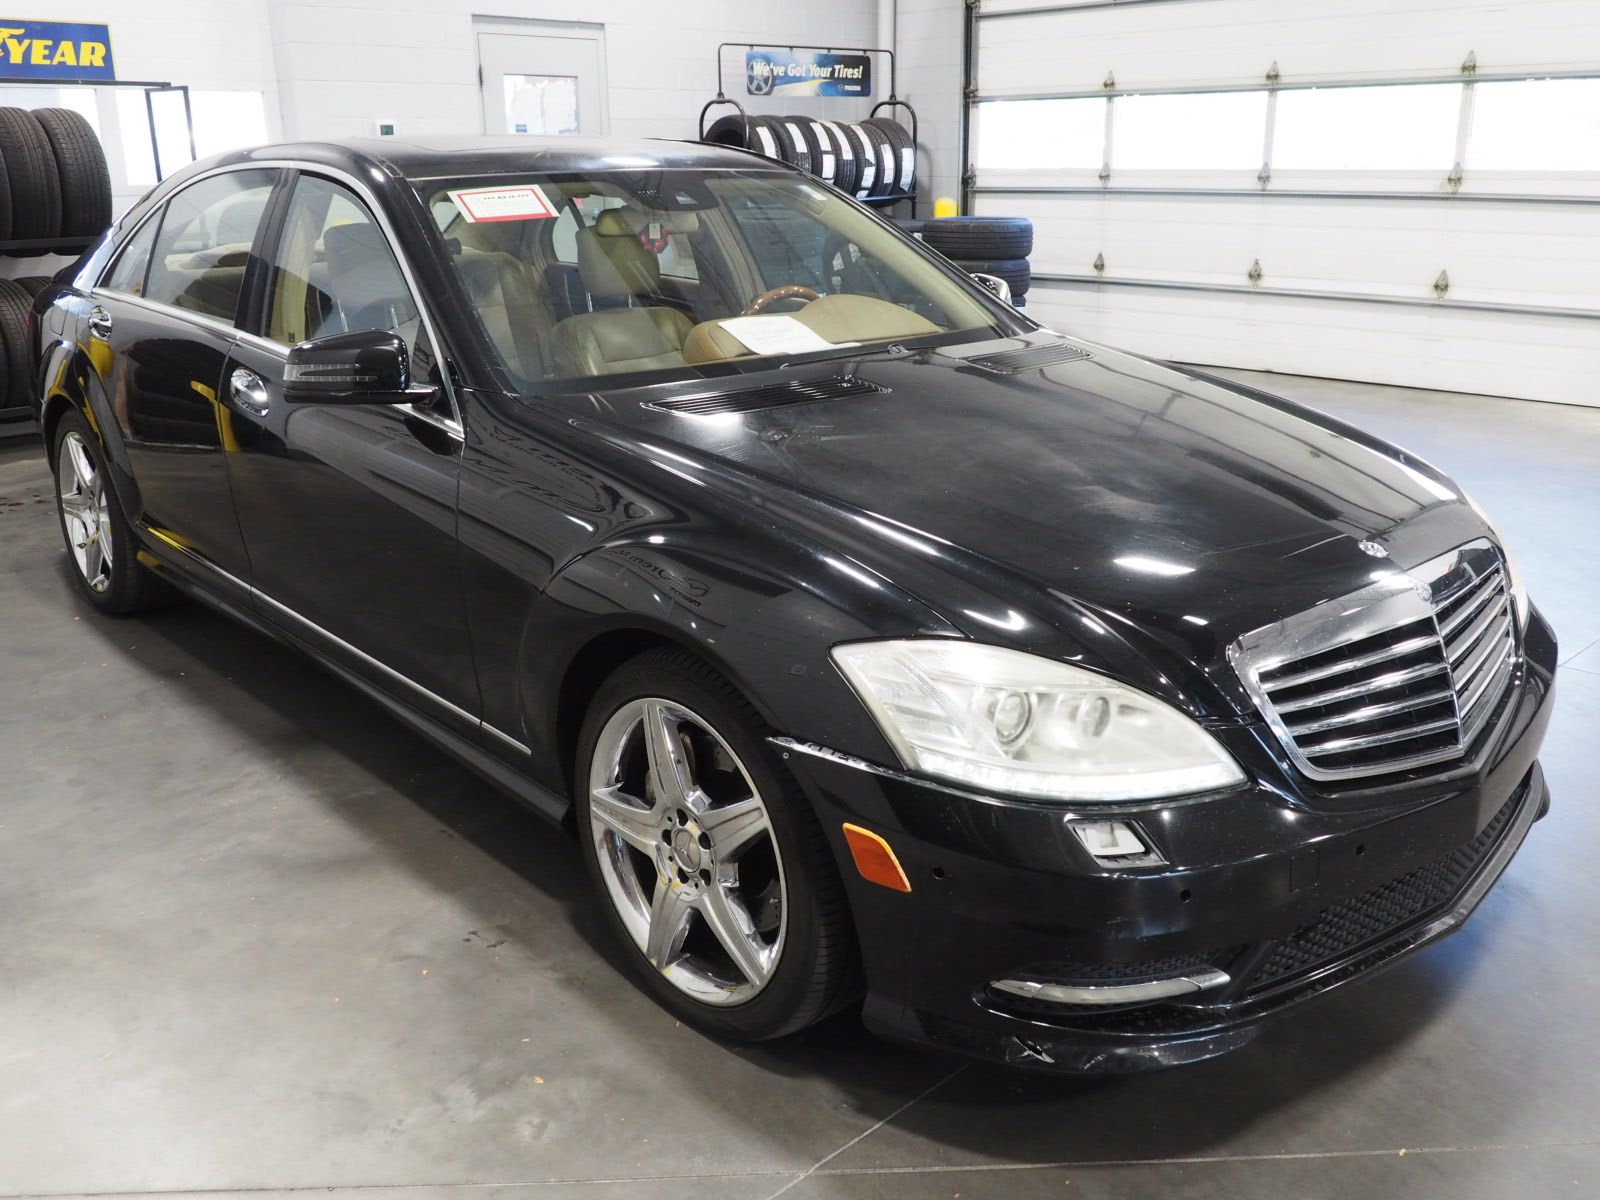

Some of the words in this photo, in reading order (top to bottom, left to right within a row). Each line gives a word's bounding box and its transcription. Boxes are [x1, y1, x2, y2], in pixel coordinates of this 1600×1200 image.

[4, 38, 106, 67] YEAR
[753, 61, 785, 76] We've
[787, 63, 807, 77] Got
[809, 63, 832, 78] Your
[834, 64, 863, 79] Tires!
